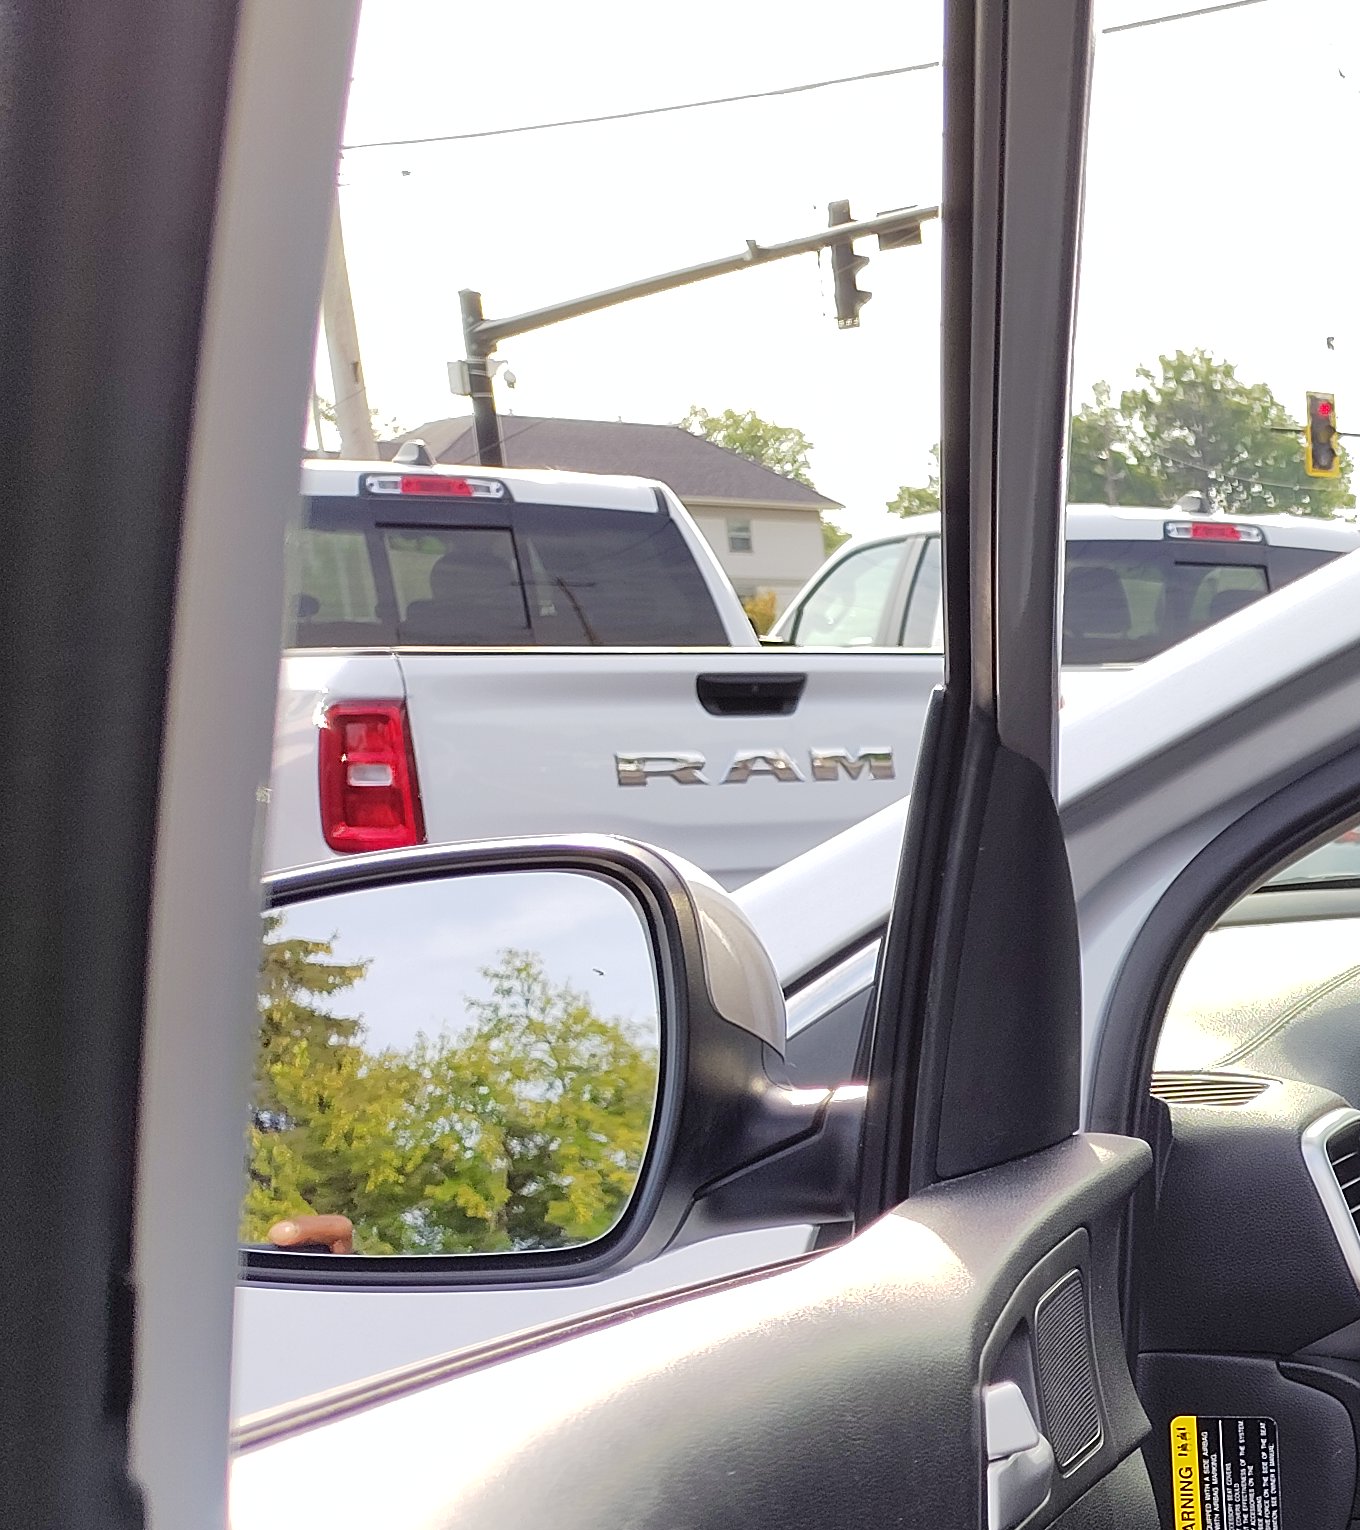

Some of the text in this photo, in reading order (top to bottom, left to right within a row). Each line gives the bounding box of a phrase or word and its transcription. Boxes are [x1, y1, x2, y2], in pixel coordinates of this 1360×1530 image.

[614, 746, 896, 786] RAM
[1201, 1432, 1209, 1456] AIRBAG
[1212, 1487, 1220, 1511] AIRBAG
